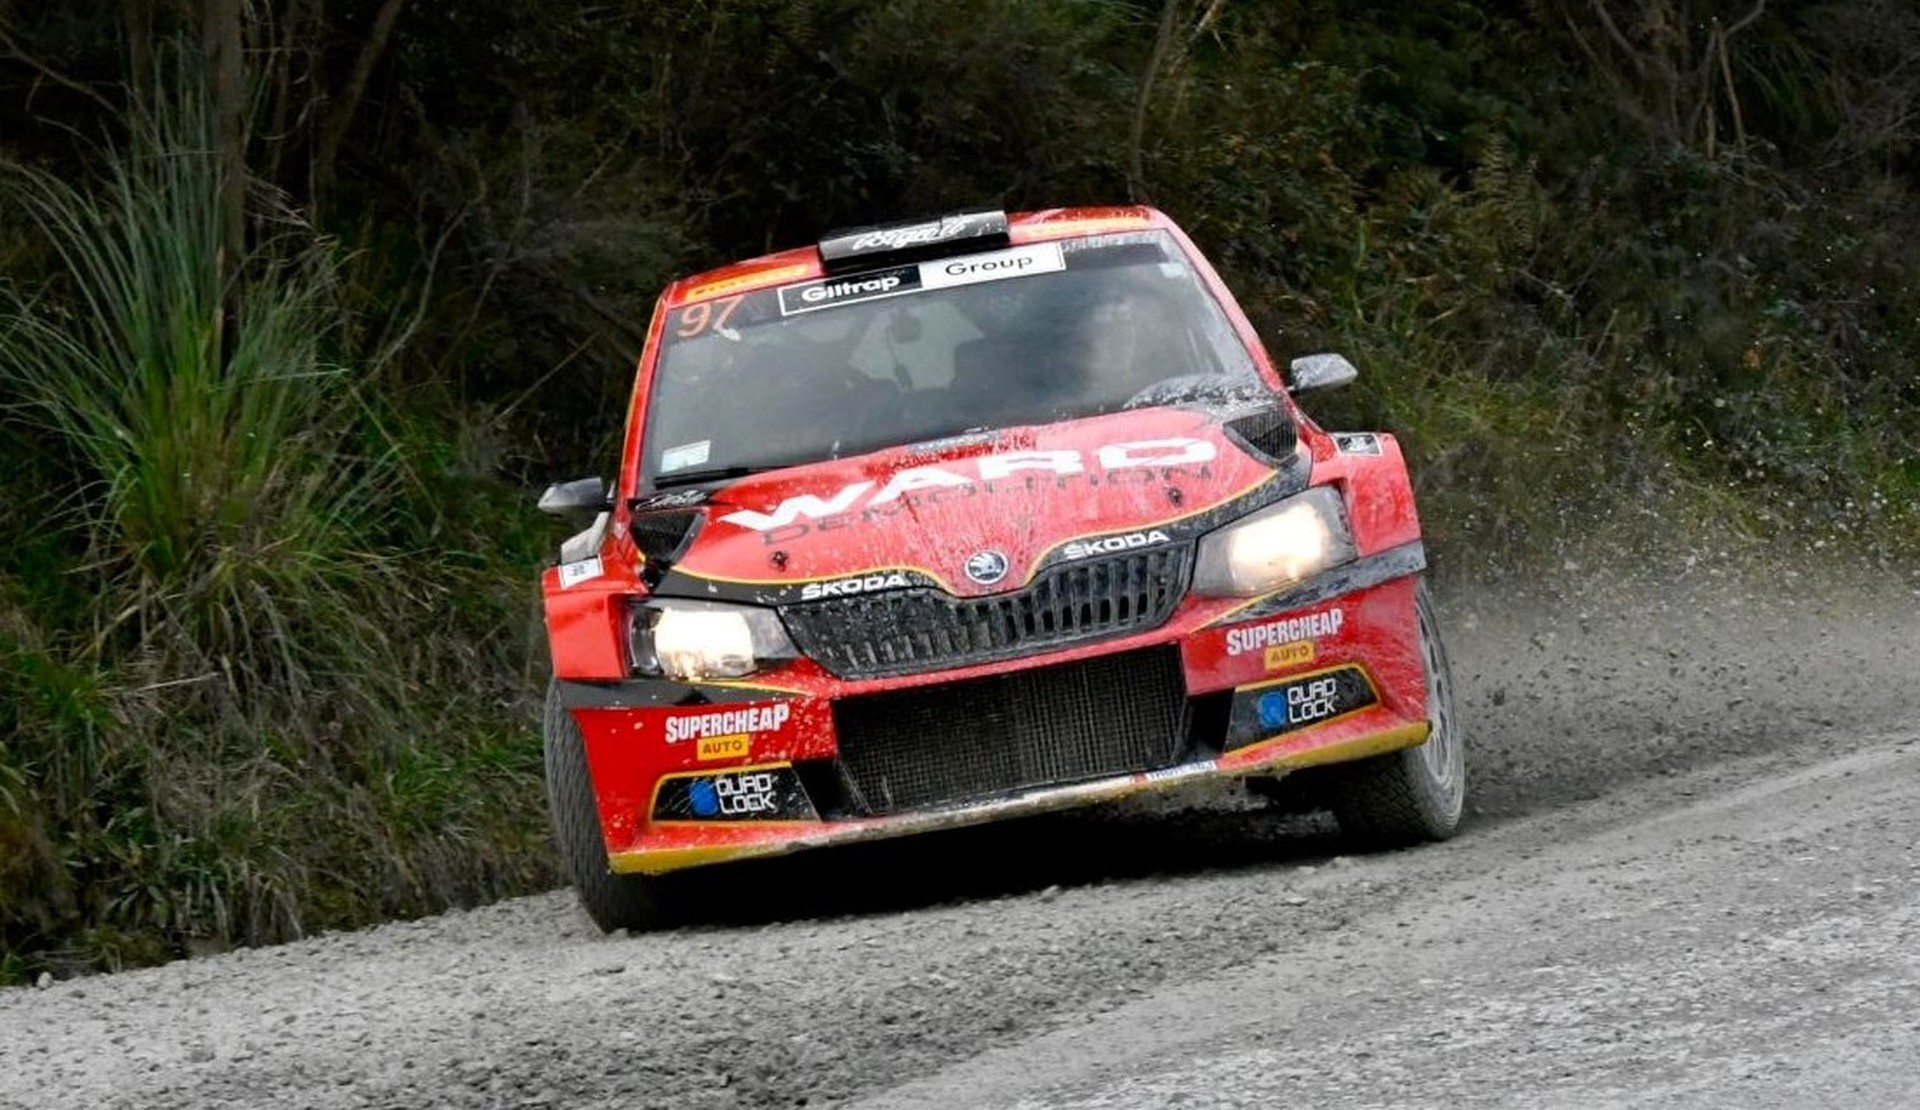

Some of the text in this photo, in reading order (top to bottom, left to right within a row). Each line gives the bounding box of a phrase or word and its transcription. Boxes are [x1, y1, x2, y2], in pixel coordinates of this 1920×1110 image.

[801, 276, 900, 302] Giltrap
[945, 254, 1034, 277] Group
[677, 294, 743, 338] 97
[717, 437, 1217, 532] WARD
[1226, 608, 1344, 656] SUPERCHEAP
[1270, 644, 1310, 662] AUTO
[1287, 677, 1337, 705] QUAD
[665, 702, 790, 744] SUPERCHEAP
[1288, 699, 1337, 723] LOCK
[702, 740, 743, 755] AUTO
[715, 773, 773, 797] QUAD
[719, 792, 777, 814] LOCK
